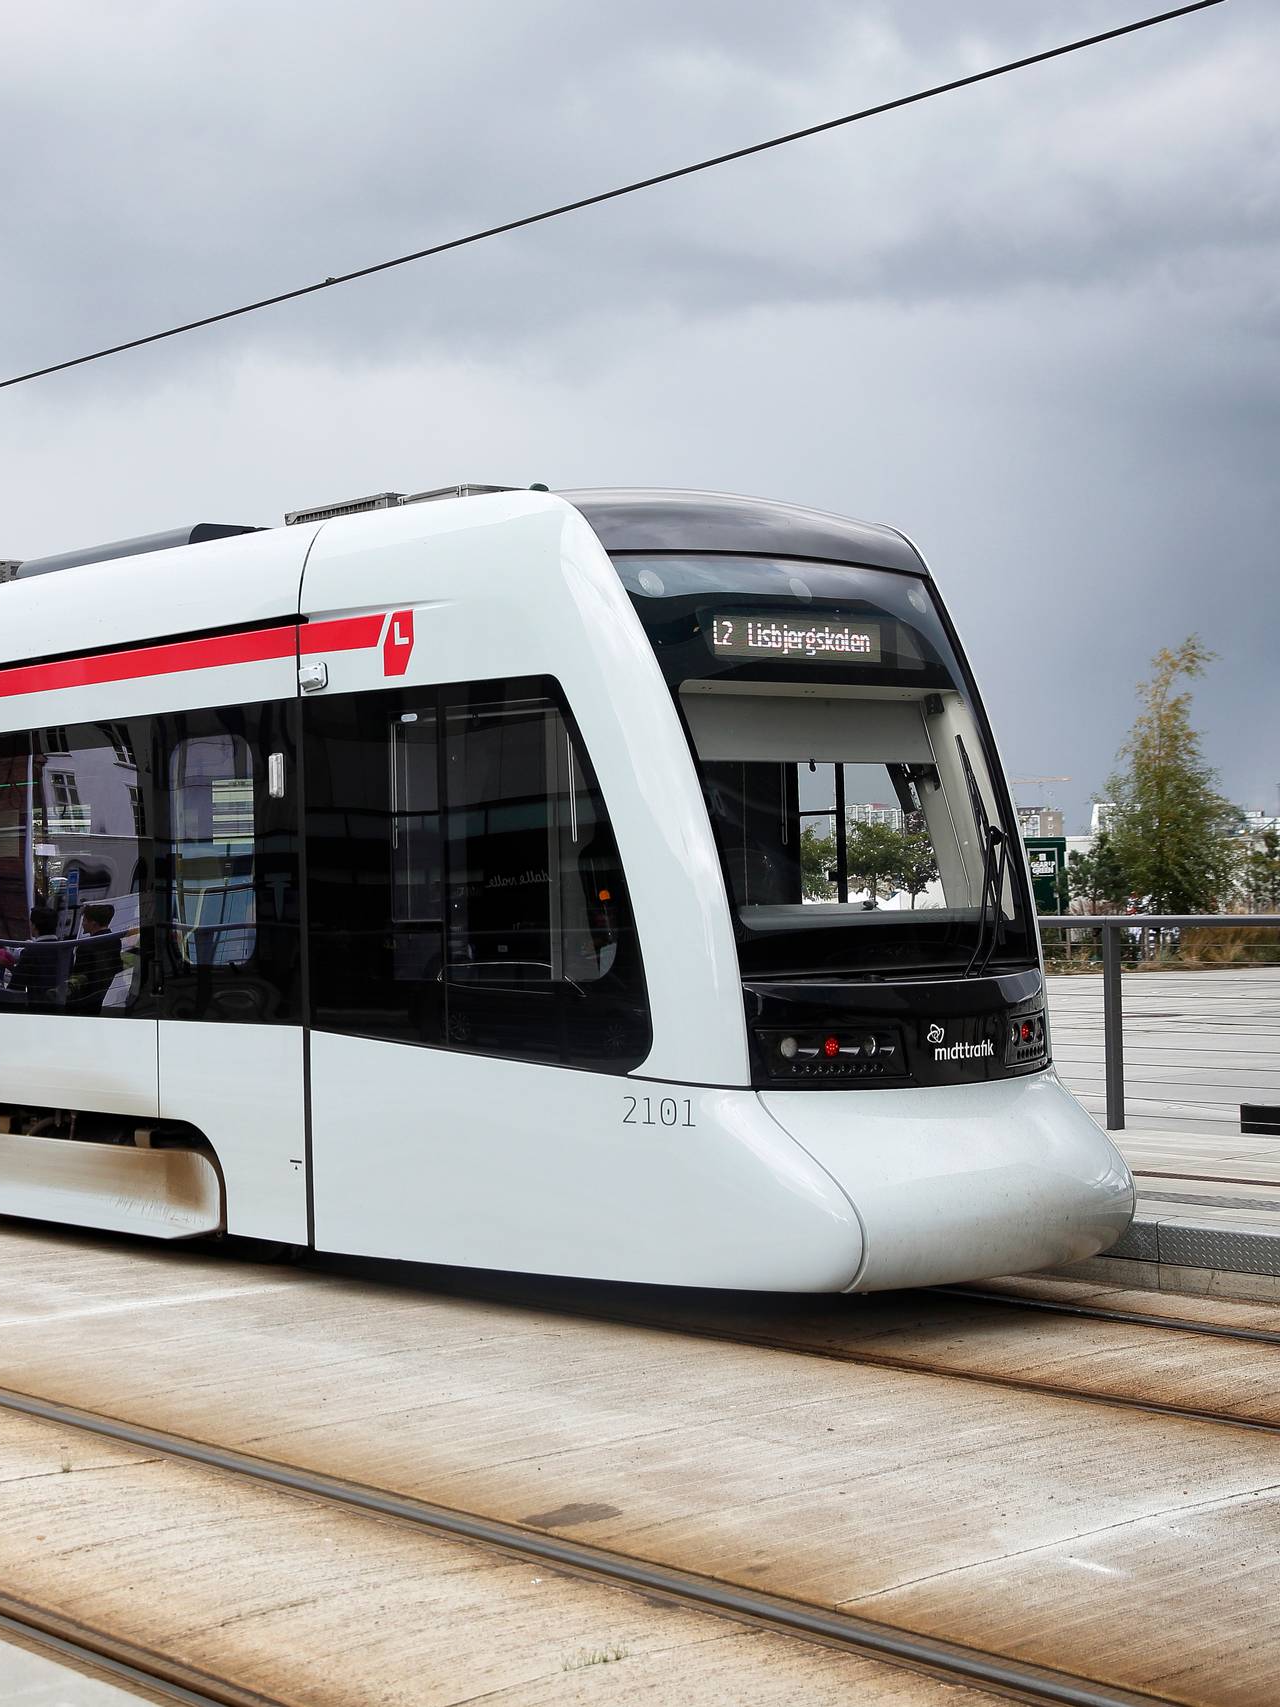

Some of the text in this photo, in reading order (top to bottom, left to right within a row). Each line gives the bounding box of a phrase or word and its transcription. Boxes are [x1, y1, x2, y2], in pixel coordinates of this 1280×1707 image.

[394, 621, 409, 645] L
[713, 620, 871, 656] L2 Lisbjergskolen
[935, 1039, 995, 1060] midttrafik
[623, 1096, 696, 1127] 2101
